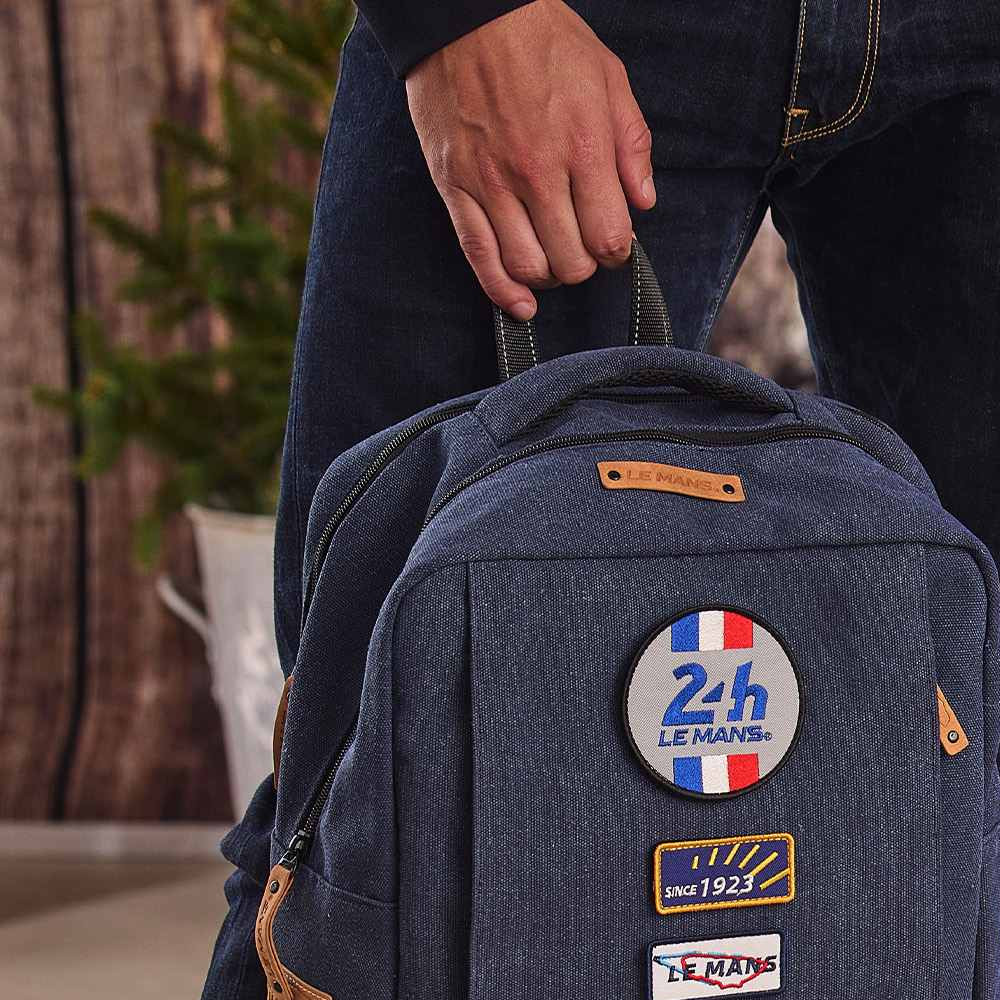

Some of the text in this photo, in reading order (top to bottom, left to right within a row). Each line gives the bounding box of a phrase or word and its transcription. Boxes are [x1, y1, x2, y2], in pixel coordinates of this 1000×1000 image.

[626, 469, 713, 492] LE MANS
[661, 661, 769, 727] 24h
[658, 729, 688, 747] LE
[665, 873, 755, 899] SINCE 1923
[667, 954, 778, 983] LE MANS
